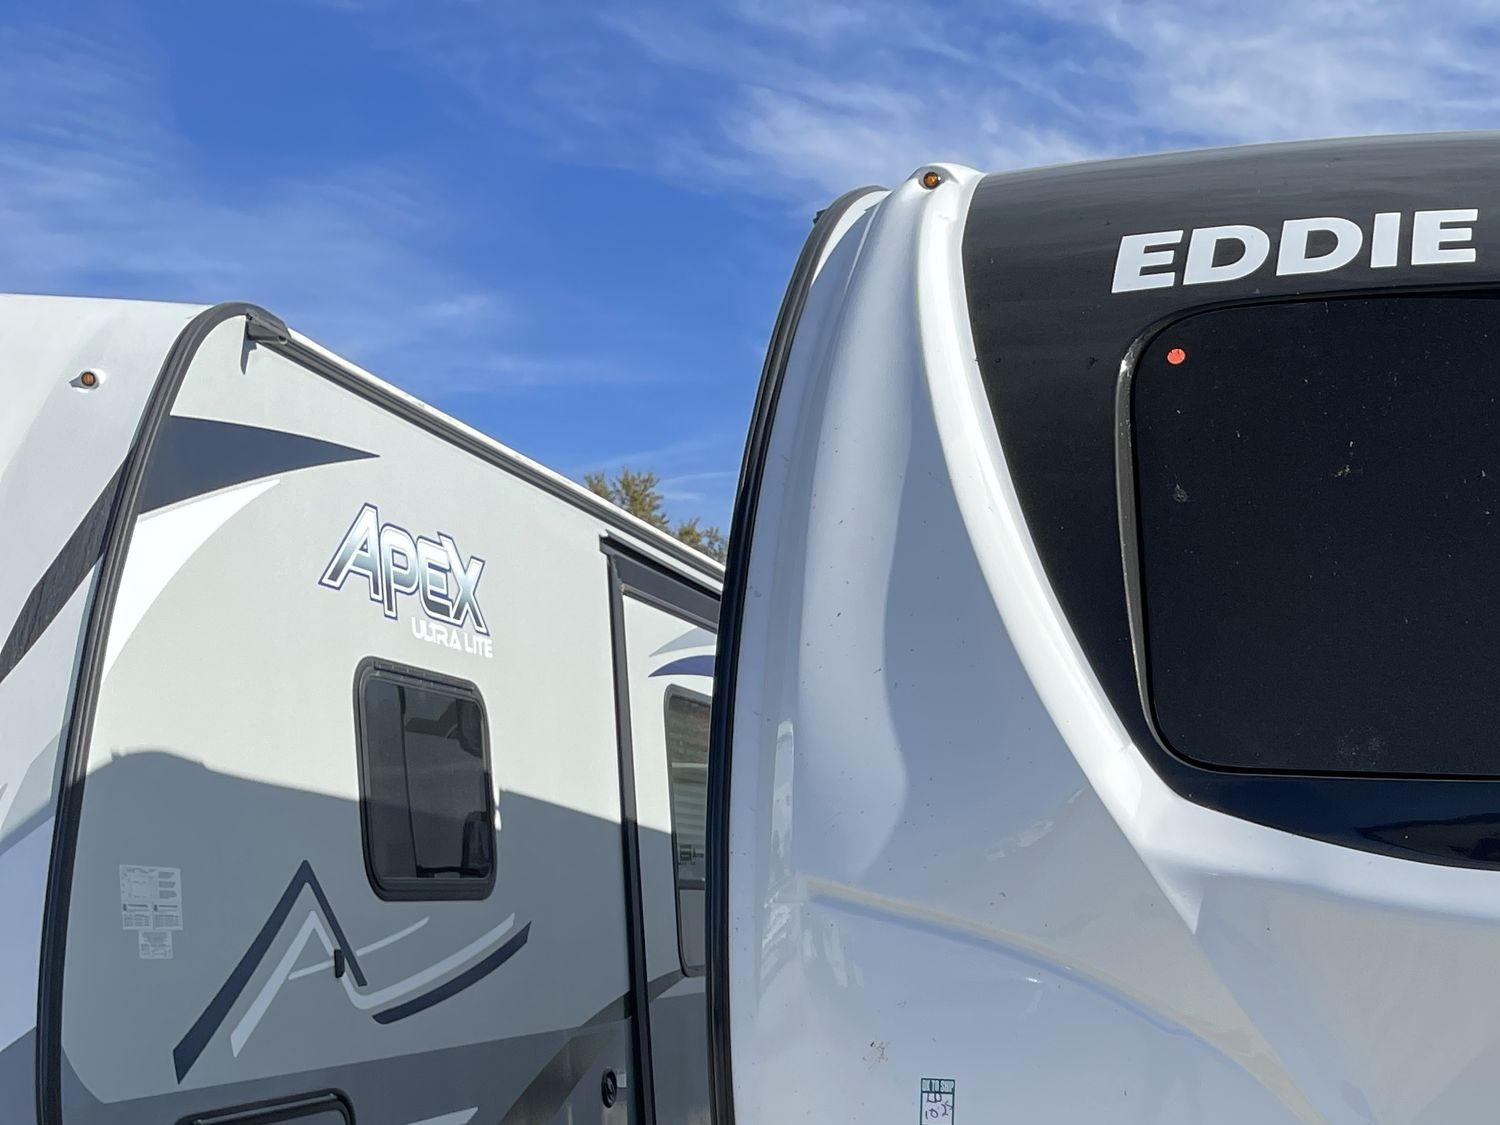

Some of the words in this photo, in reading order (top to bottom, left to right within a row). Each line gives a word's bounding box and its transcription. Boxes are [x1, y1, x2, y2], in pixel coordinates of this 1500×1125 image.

[1111, 208, 1478, 293] EDDIE
[318, 502, 490, 636] APEX
[411, 616, 462, 651] ULTRA
[464, 635, 493, 659] LITE
